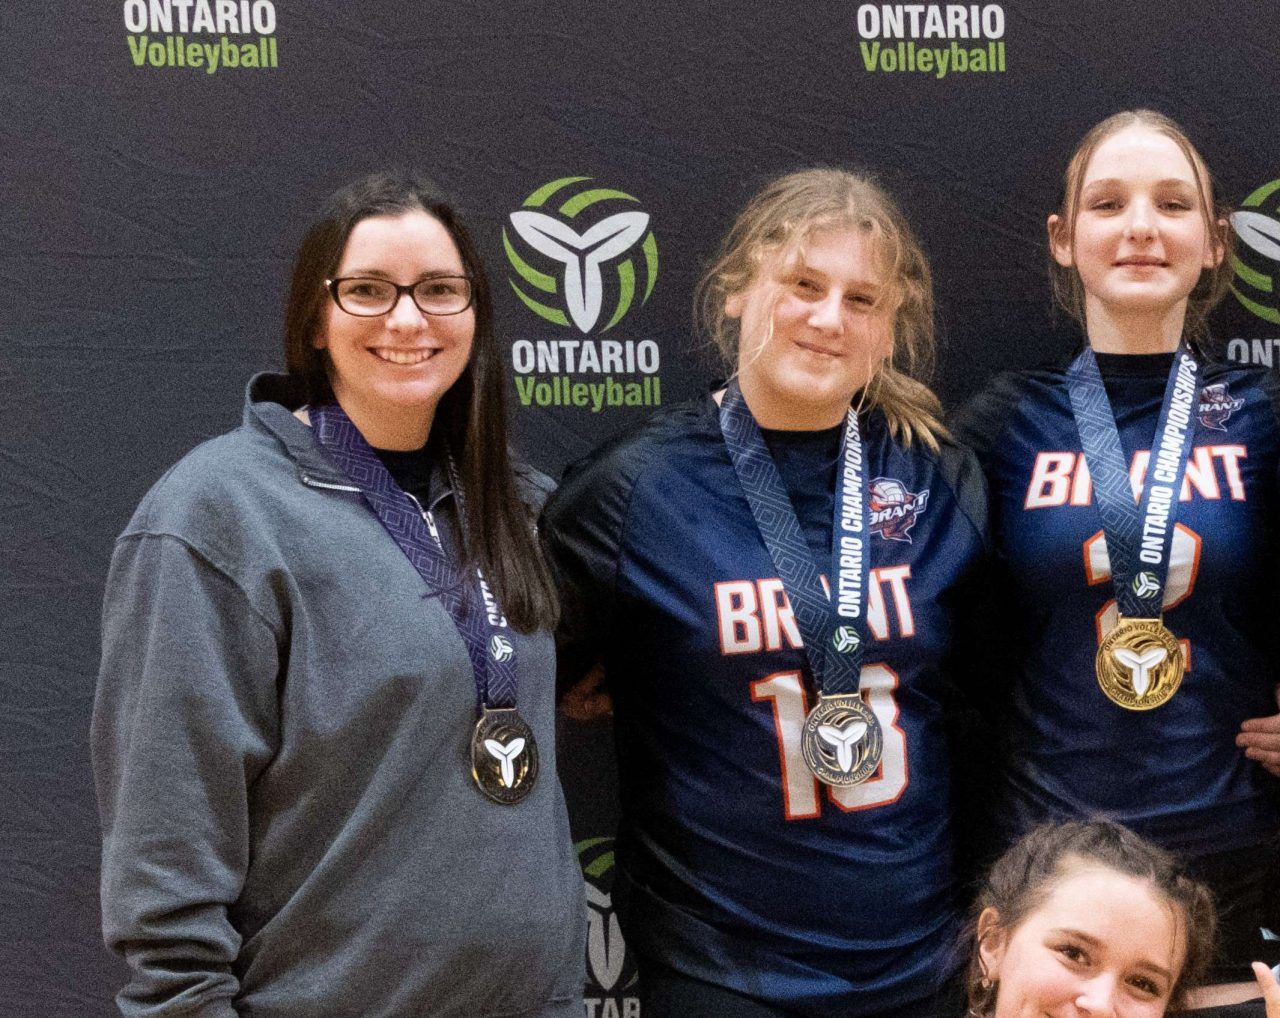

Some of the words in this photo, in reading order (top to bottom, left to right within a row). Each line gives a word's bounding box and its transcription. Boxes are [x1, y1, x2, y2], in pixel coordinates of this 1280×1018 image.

[124, 0, 277, 34] ONTARIO
[857, 4, 1005, 39] ONTARIO
[127, 35, 278, 74] Volleyball
[859, 41, 1006, 79] Volleyball
[512, 339, 660, 374] ONTARIO
[514, 376, 661, 413] Volleyball
[1154, 354, 1198, 483] CHAMPIONSHIPS
[841, 407, 863, 532] CHAMPIONSHI
[1139, 486, 1173, 564] ONTARIO
[838, 537, 863, 618] ONTARIO
[714, 564, 916, 657] BRNT
